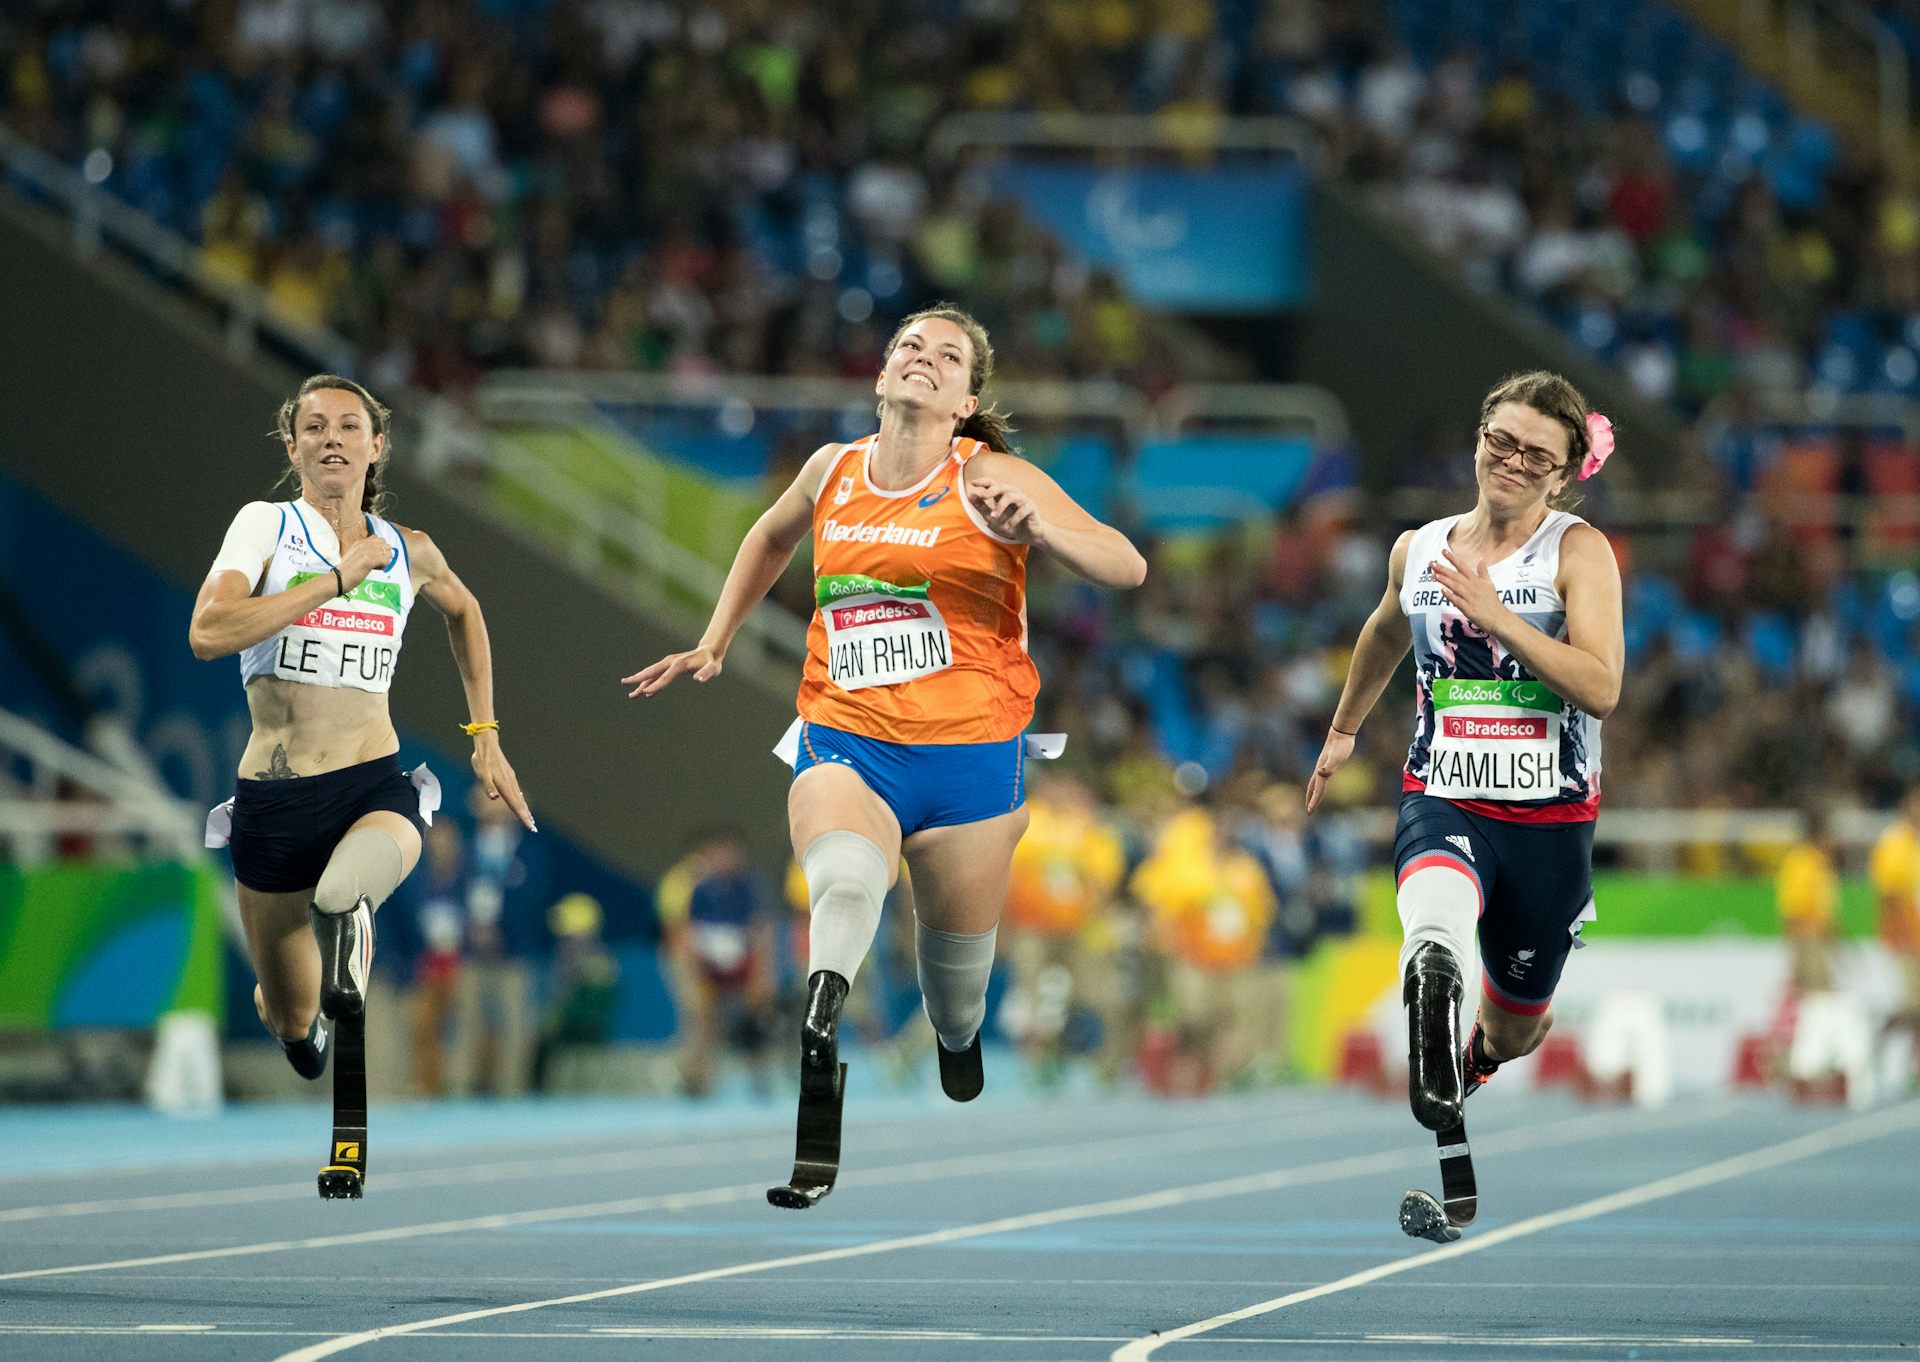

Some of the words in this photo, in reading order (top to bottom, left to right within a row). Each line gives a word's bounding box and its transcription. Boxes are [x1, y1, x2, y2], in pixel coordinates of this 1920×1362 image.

[821, 519, 941, 547] Nederland
[1413, 590, 1456, 607] GREA
[322, 612, 385, 632] Bradesco
[854, 604, 918, 624] Bradesco
[279, 636, 321, 674] LE
[340, 643, 393, 682] FUR
[830, 640, 864, 681] VAN
[873, 629, 947, 674] RHIJN
[1448, 684, 1501, 702] Rio2016
[1465, 720, 1535, 736] Bradesco
[1430, 748, 1554, 790] KAMLISH
